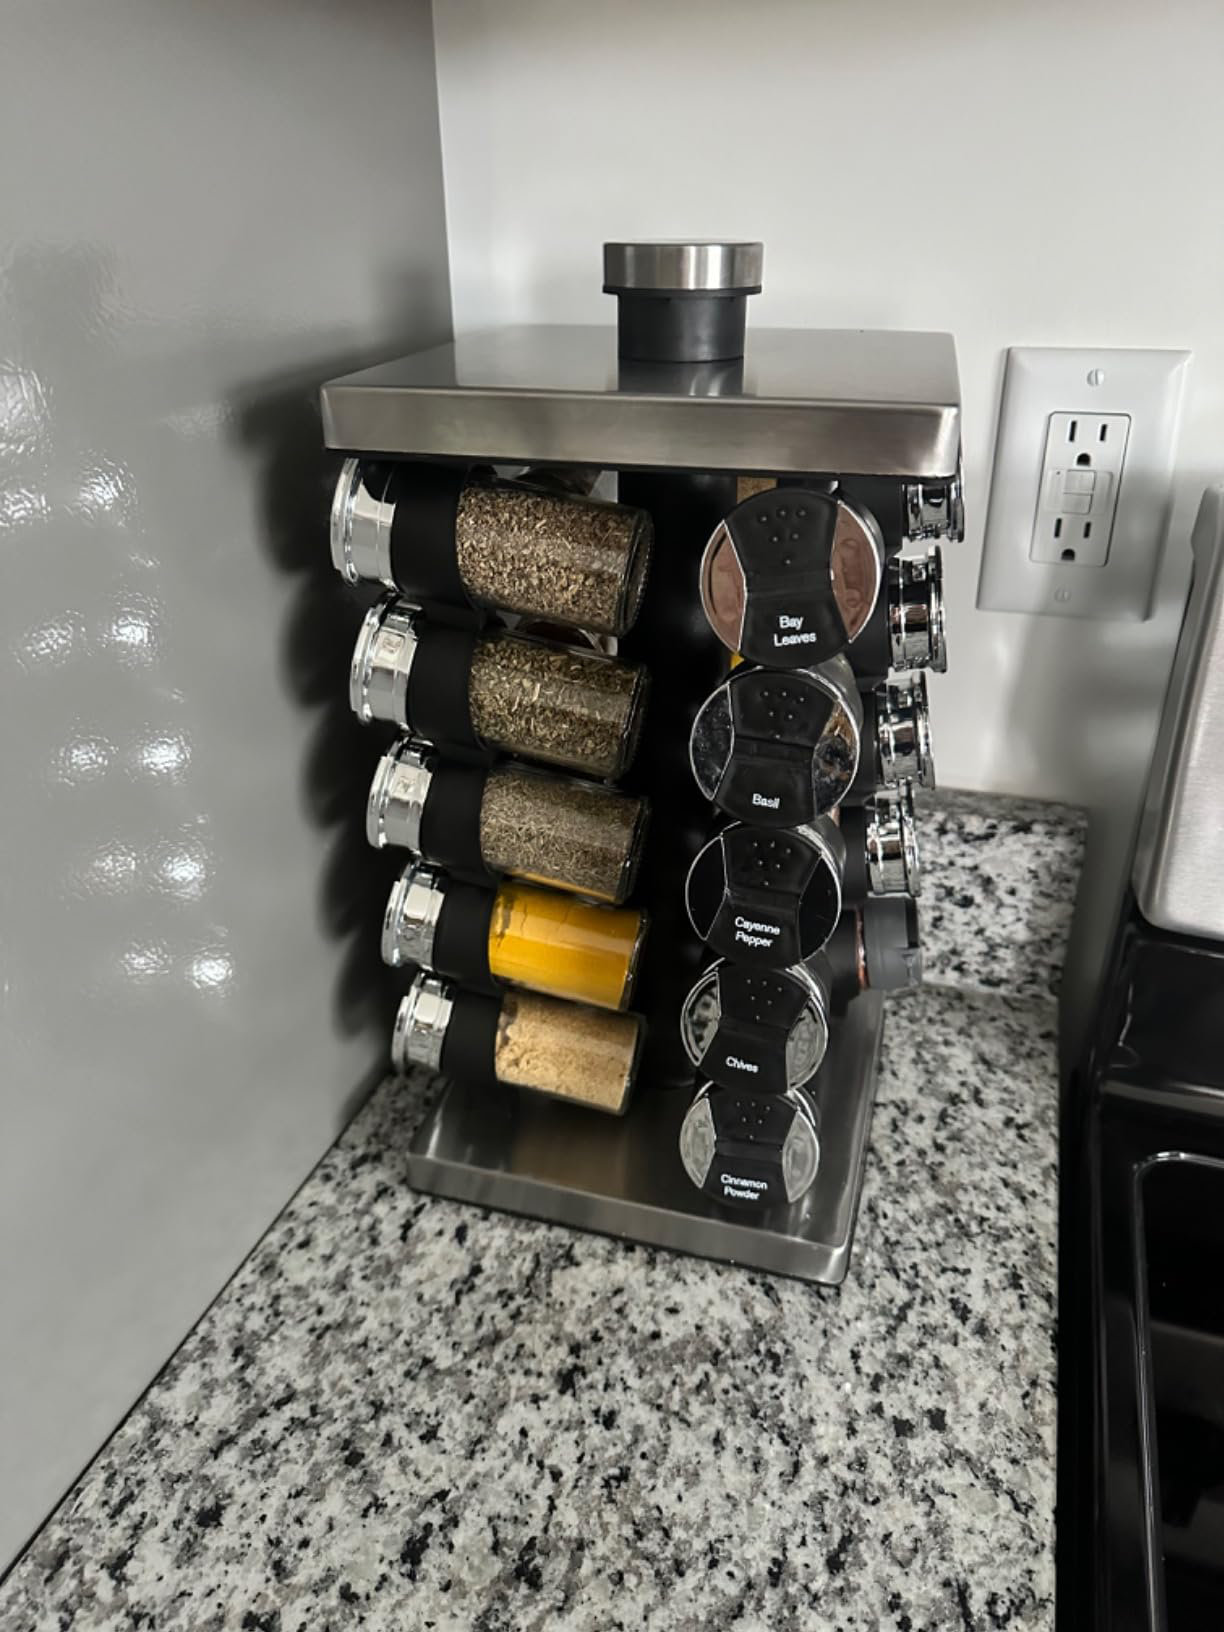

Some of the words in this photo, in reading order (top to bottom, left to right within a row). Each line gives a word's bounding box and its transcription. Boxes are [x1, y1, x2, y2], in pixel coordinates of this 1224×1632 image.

[779, 615, 804, 631] Bay
[774, 633, 817, 647] Leaves
[751, 793, 781, 809] Basil
[734, 916, 781, 936] Cayenne
[735, 931, 773, 948] Pepper
[725, 1056, 759, 1073] Chives
[720, 1173, 768, 1190] Cinnamon
[723, 1185, 760, 1200] Powder
